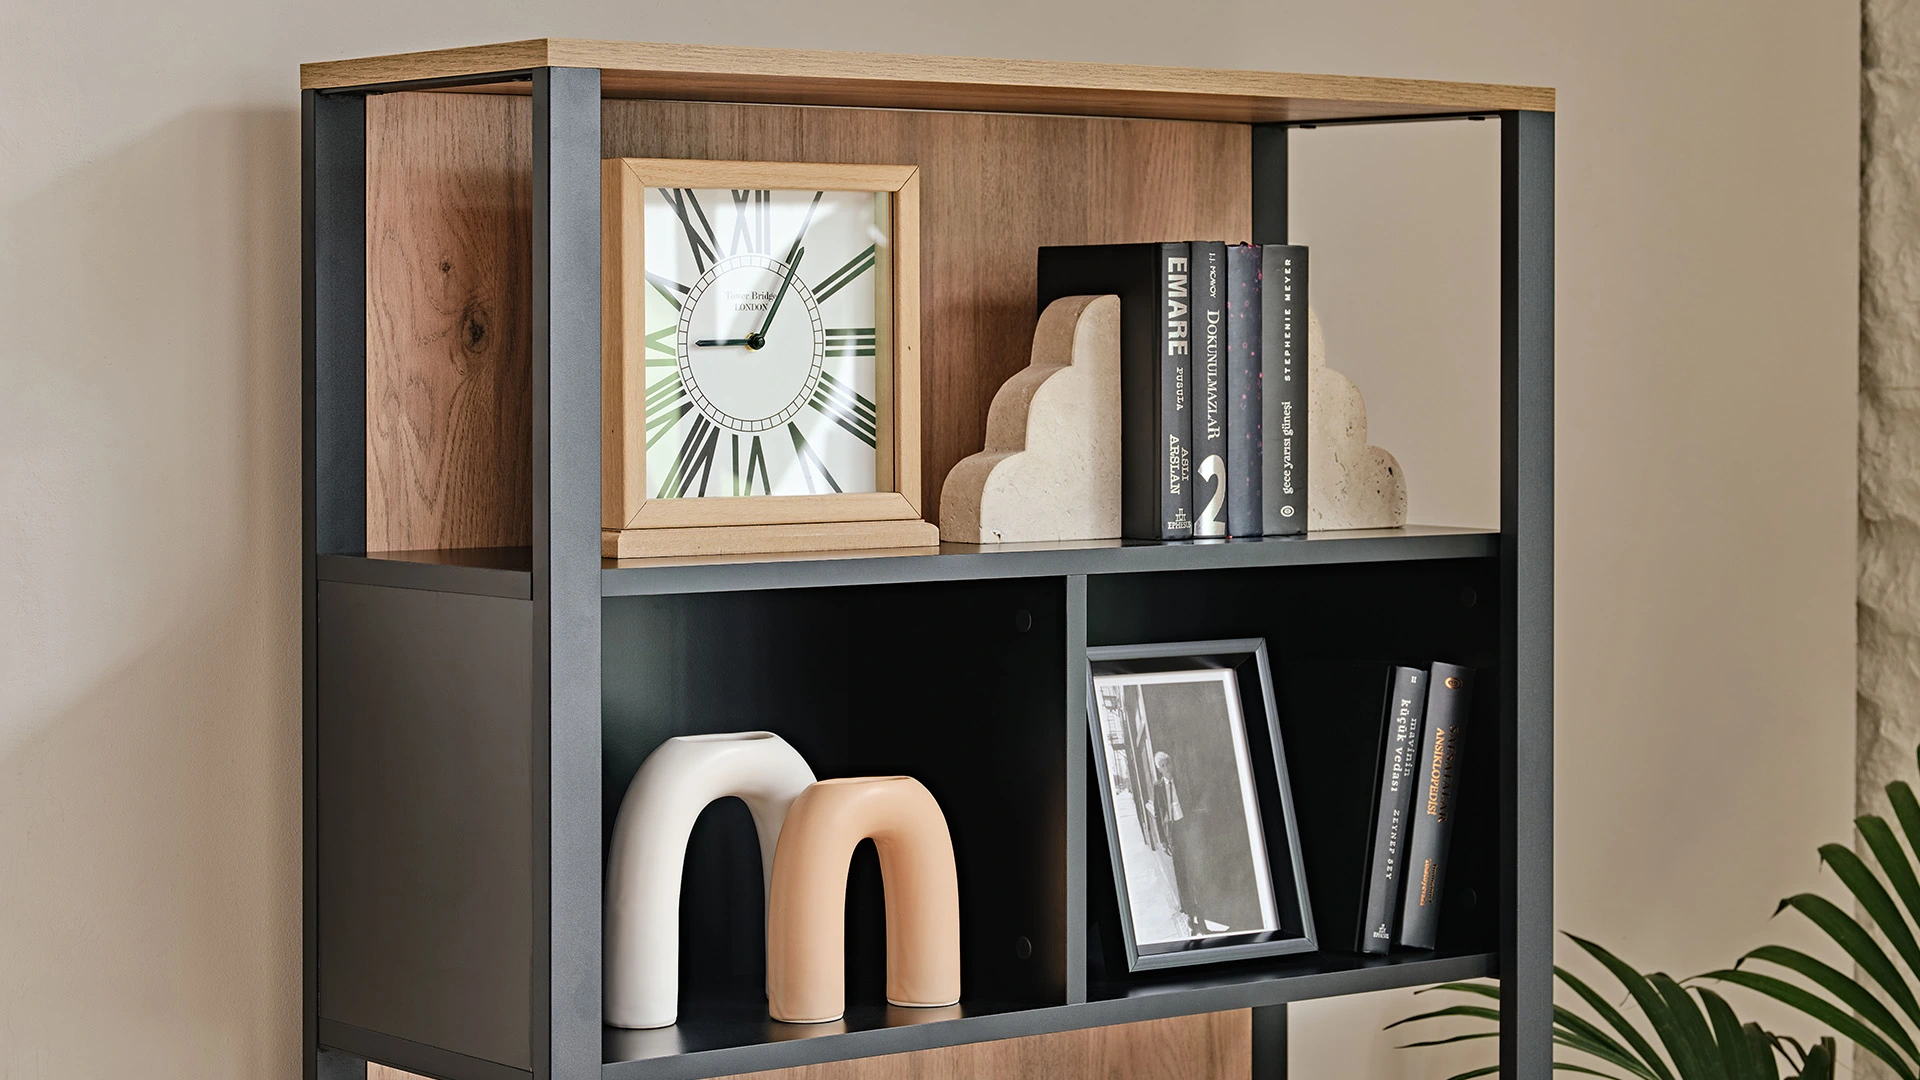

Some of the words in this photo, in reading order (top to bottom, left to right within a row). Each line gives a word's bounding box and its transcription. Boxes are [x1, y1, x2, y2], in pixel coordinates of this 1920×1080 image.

[1284, 259, 1292, 301] MEYER
[735, 303, 768, 311] LONDON
[1168, 257, 1188, 356] EMARE
[1284, 309, 1292, 382] STEPHENIE
[1176, 367, 1185, 411] PUSULA
[1206, 310, 1221, 440] DOKUNULMAZLAR
[1282, 401, 1293, 436] güneşi
[1169, 434, 1180, 495] ARSLAN
[1181, 448, 1190, 481] ASLI
[1283, 438, 1293, 469] yarısı
[1194, 454, 1226, 536] 2
[1282, 469, 1293, 494] gece
[1396, 699, 1412, 742] küçük
[1404, 718, 1417, 776] mavinin
[1391, 747, 1404, 792] vedası
[1438, 724, 1460, 823] SAFSATALAR
[1389, 809, 1400, 854] ZEYNEP
[1385, 858, 1394, 880] SEY
